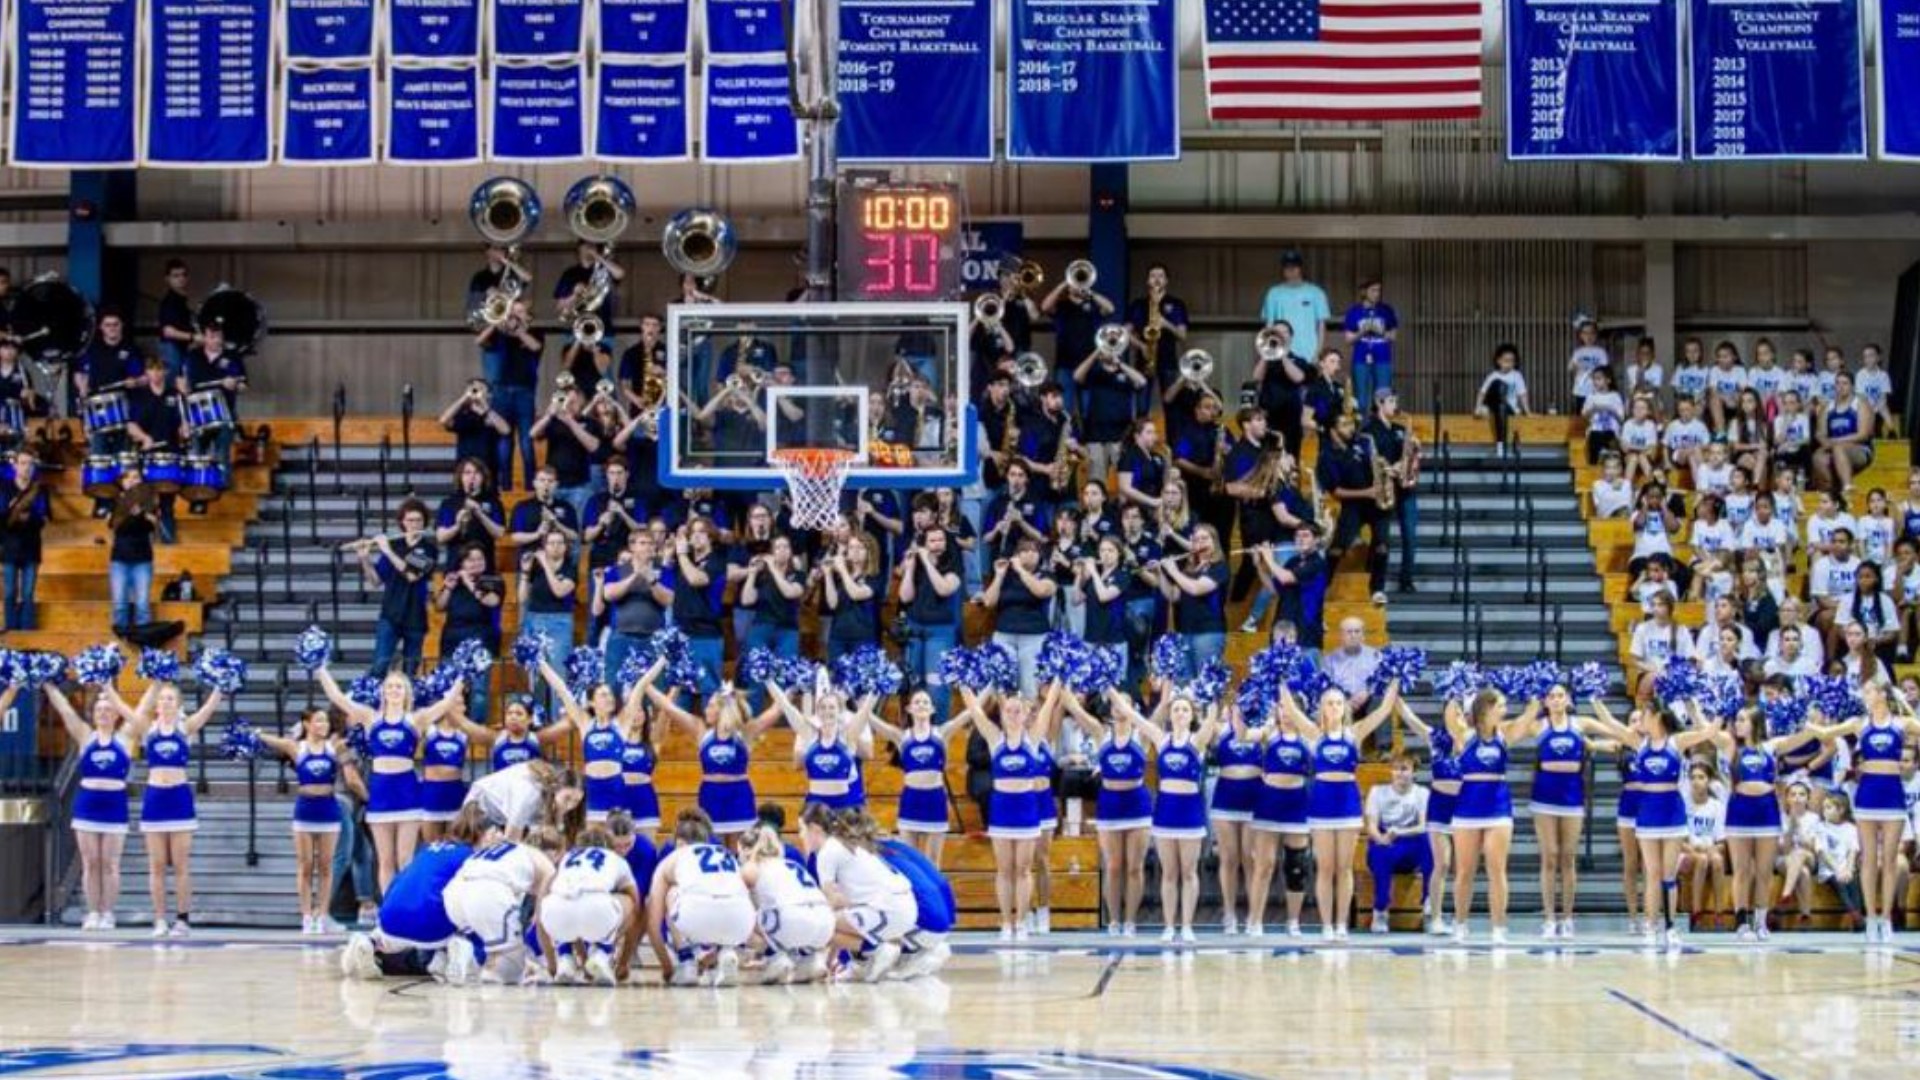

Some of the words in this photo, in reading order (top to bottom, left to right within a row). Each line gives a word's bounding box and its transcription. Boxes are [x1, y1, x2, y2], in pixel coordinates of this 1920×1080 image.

[859, 12, 951, 25] TOURNAMENT
[1033, 12, 1095, 24] REGULAR
[1100, 12, 1147, 24] SEASON
[1535, 10, 1596, 22] REGULAR
[1601, 10, 1650, 21] SEASON
[1730, 9, 1820, 22] TOURNAMENT
[869, 27, 945, 38] CHAMPIONS
[1055, 26, 1130, 38] CHAMPIONS
[1559, 23, 1634, 34] CHAMPIONS
[1737, 22, 1813, 34] CHAMPIONS
[900, 40, 980, 52] BASKETBALL
[1021, 39, 1081, 51] WOMEN'S
[1086, 39, 1165, 51] BASKETBALL
[1557, 39, 1636, 51] VOLLEYBALL
[1735, 39, 1817, 51] VOLLEYBALL
[1018, 60, 1076, 74] 2016-17
[1531, 57, 1564, 71] 2013
[1714, 57, 1746, 71] 2013
[1018, 78, 1078, 92] 2018-19
[1531, 75, 1566, 89] 2014
[1714, 75, 1745, 88] 2014
[1531, 92, 1564, 106] 2015
[1714, 92, 1746, 106] 2015
[1714, 109, 1745, 123] 2017
[1531, 126, 1564, 140] 2019
[1714, 126, 1745, 140] 2018
[1714, 143, 1746, 155] 2019
[864, 196, 949, 229] 10:00
[865, 234, 938, 292] 30
